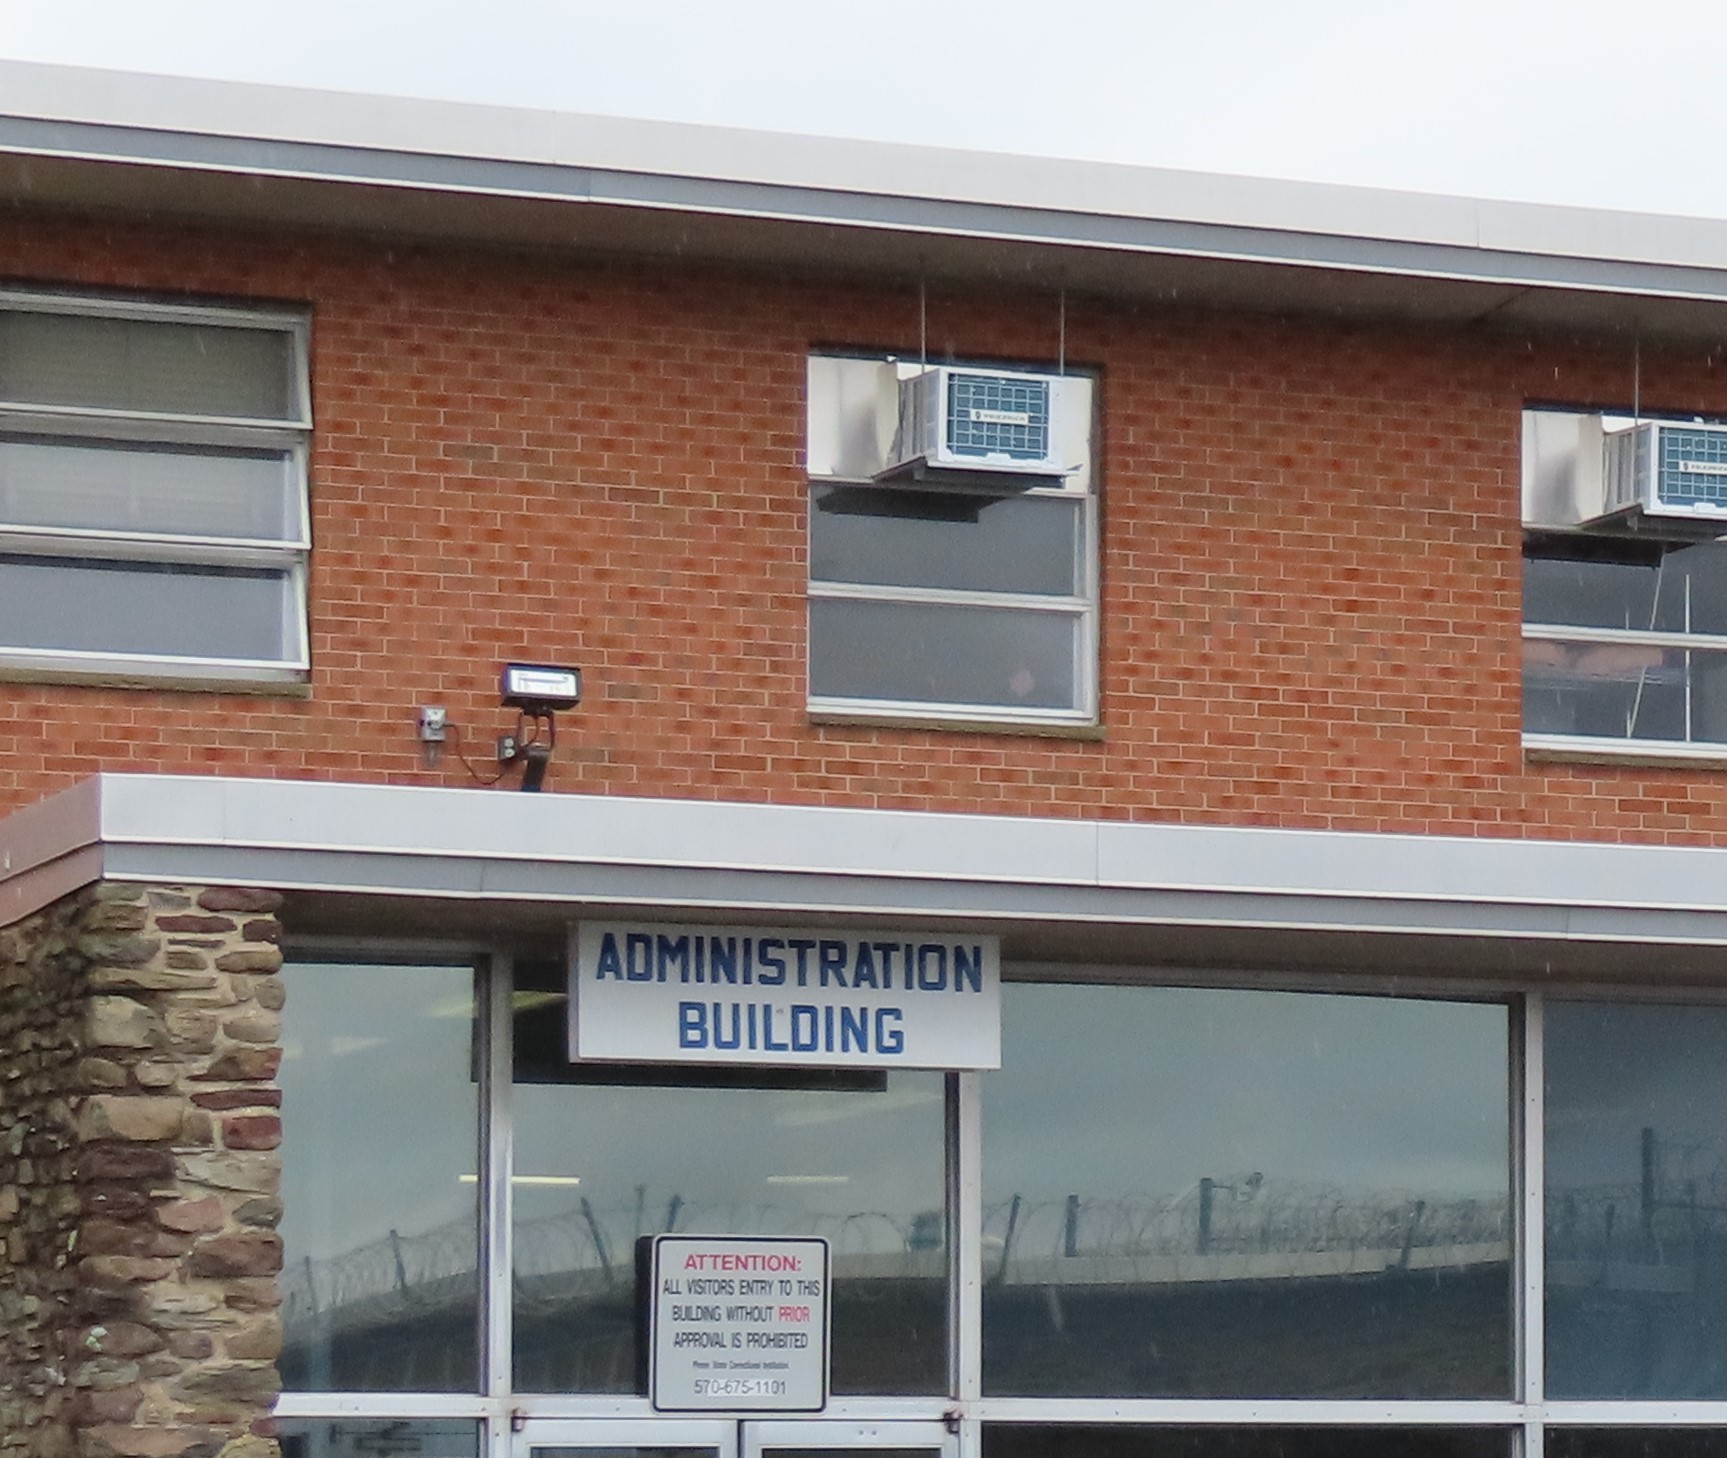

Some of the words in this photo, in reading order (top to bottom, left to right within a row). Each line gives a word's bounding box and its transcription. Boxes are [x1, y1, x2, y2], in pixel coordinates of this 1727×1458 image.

[596, 932, 983, 993] ADMINISTRATION
[678, 1001, 905, 1055] BUILDING
[684, 1254, 802, 1272] ATTENTION:
[662, 1279, 682, 1295] ALL
[687, 1279, 735, 1296] VISITORS
[739, 1279, 773, 1296] ENTRY
[778, 1280, 792, 1296] TO
[797, 1280, 821, 1296] THIS
[672, 1305, 721, 1322] BUILDING
[726, 1305, 775, 1322] WITHOUT
[778, 1306, 811, 1322] PRIOR
[673, 1332, 726, 1349] APPROVAL
[731, 1332, 742, 1349] IS
[747, 1332, 808, 1349] PROHIBITED
[694, 1379, 787, 1395] 570-675-1101
